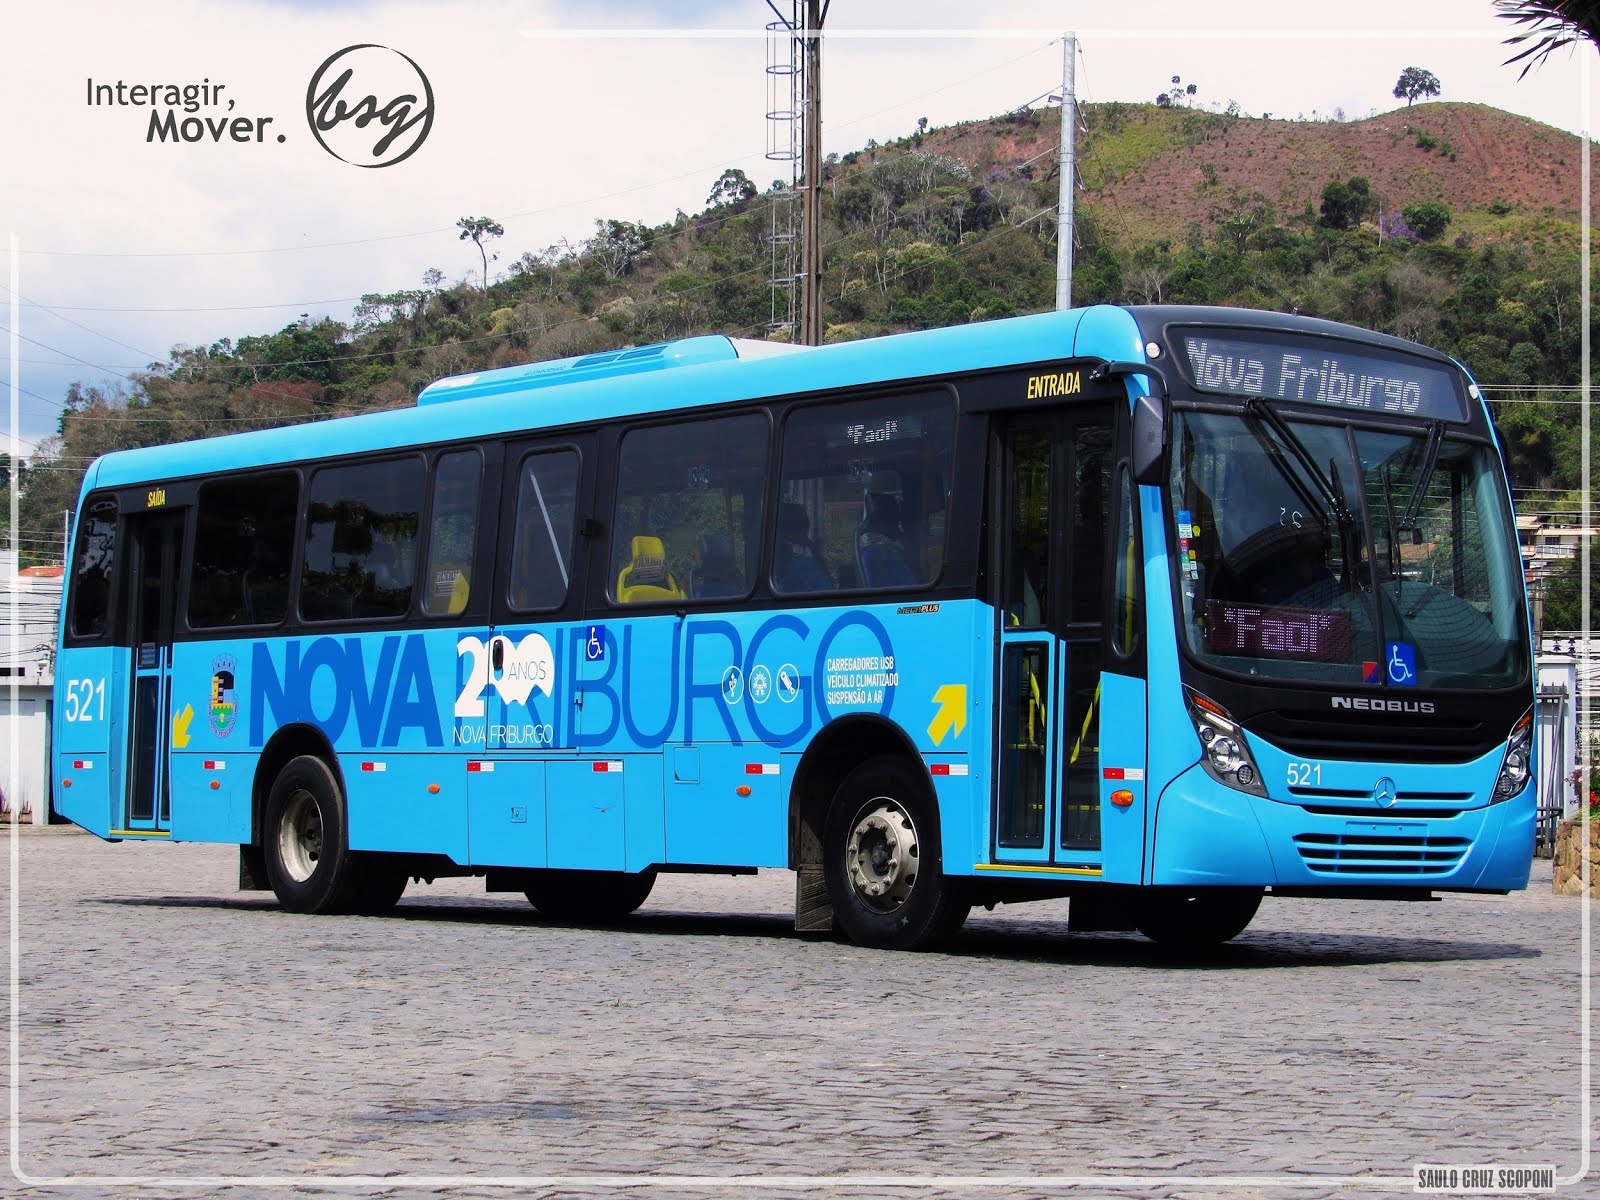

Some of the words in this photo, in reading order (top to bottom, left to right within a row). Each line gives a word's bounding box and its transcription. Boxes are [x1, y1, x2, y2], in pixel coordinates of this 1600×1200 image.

[1027, 371, 1081, 399] ENTRADA
[1187, 341, 1264, 392] Nova
[1278, 354, 1420, 413] Friburgo
[147, 487, 166, 508] SAÍDA
[508, 661, 547, 681] ANOS
[827, 657, 879, 671] CARREGADORES
[880, 656, 894, 670] USB
[827, 672, 855, 688] VEÍCULO
[856, 672, 899, 687] CLIMATIZADO
[65, 677, 105, 722] 521
[250, 634, 444, 747] NOVA
[827, 688, 866, 705] SUSPENSÃO
[867, 691, 873, 704] A
[873, 690, 883, 703] AR
[1331, 697, 1435, 714] NEOBUS
[453, 725, 486, 744] NOVA
[490, 724, 554, 744] FRIBURGO
[1286, 762, 1322, 786] 521
